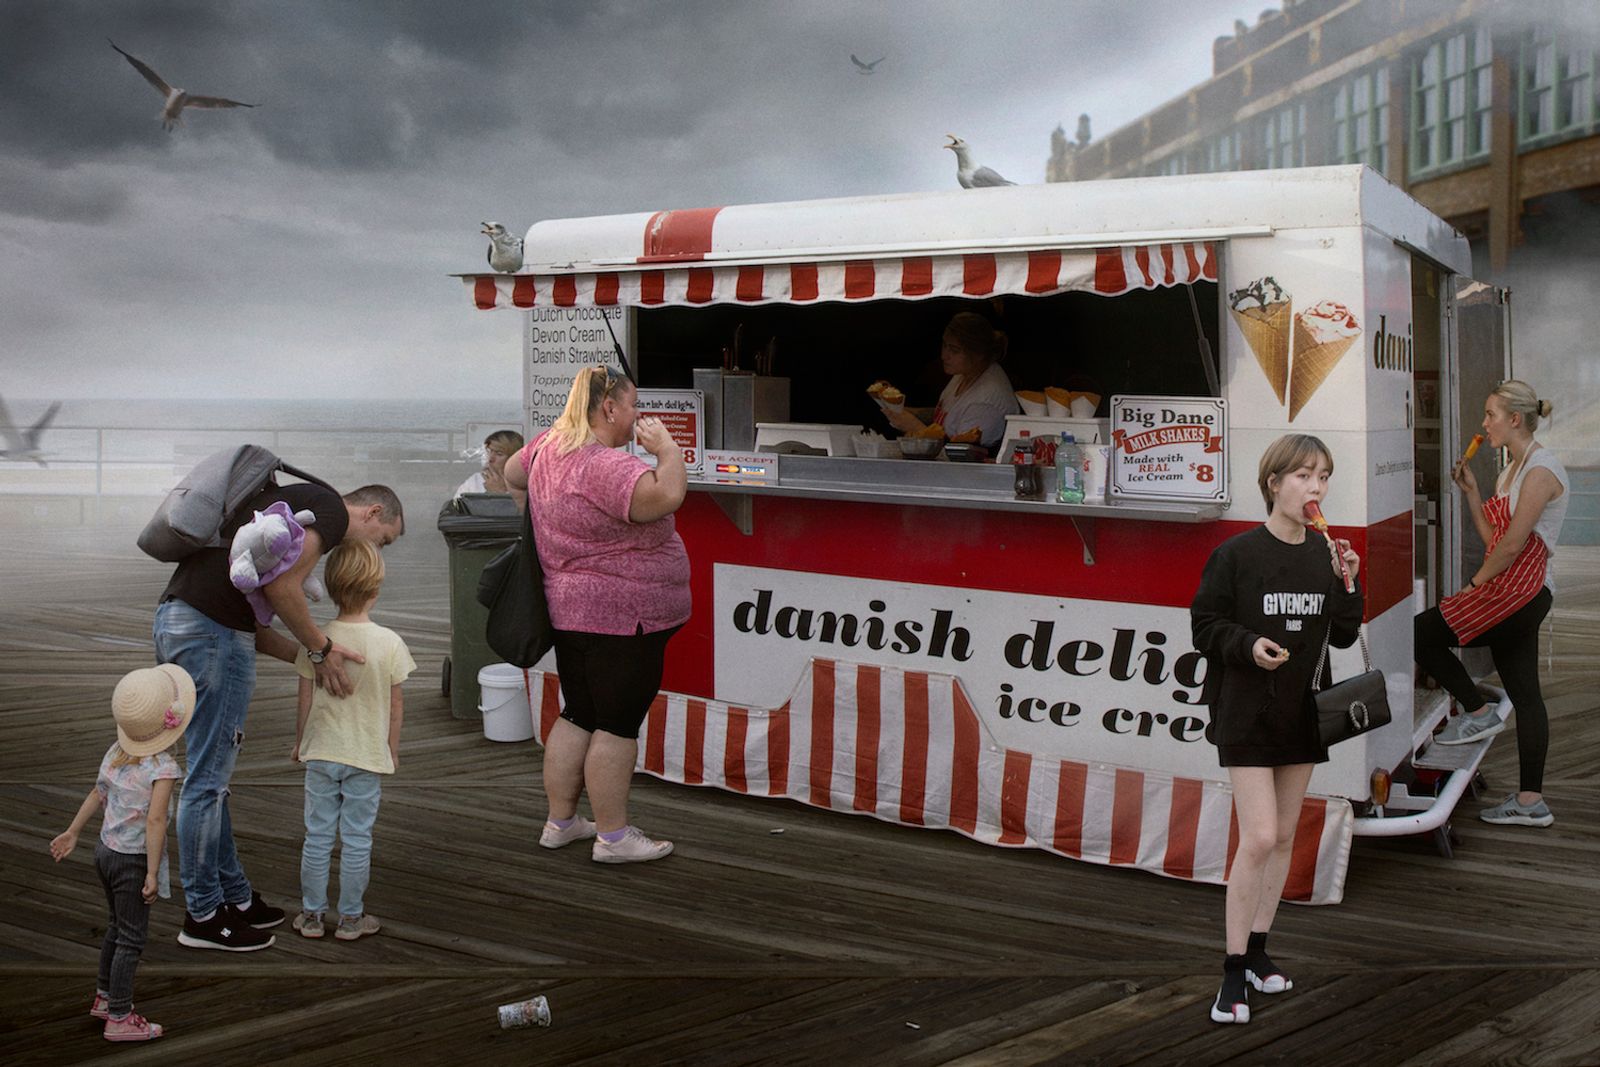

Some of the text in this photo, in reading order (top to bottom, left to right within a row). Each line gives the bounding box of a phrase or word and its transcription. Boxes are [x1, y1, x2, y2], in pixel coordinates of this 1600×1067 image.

[532, 308, 563, 322] Dutch
[532, 326, 606, 343] Devon Cream
[532, 347, 566, 364] Danish
[532, 389, 570, 407] Choco
[1122, 408, 1214, 428] Big Dane
[1129, 427, 1206, 452] MILK SHAKES
[729, 456, 775, 464] ACCEPT
[1123, 453, 1184, 464] Made with
[1138, 463, 1171, 473] REAL
[1128, 472, 1184, 482] Ice Cream
[1263, 592, 1326, 616] GIVENCHY
[733, 588, 974, 662] danish
[996, 683, 1082, 727] ice
